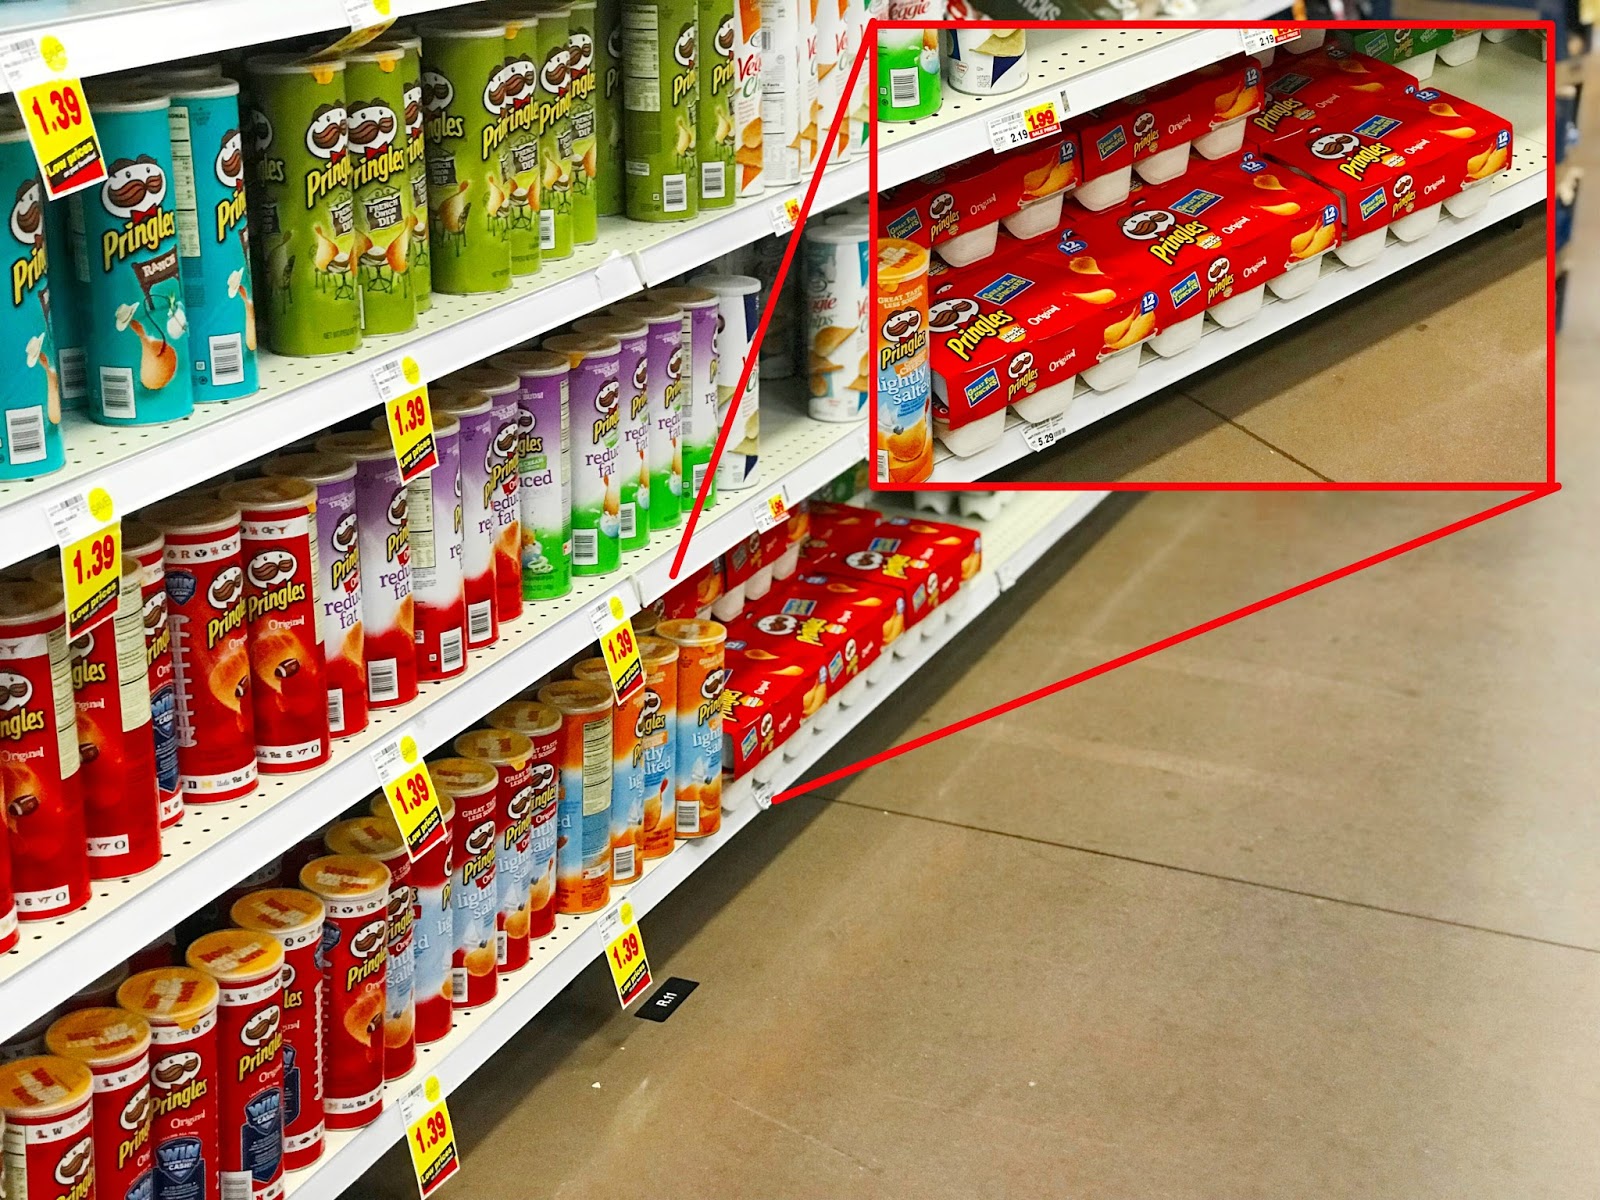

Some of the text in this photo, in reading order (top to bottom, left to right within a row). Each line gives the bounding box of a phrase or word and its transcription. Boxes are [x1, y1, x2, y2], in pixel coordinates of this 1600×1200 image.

[1259, 36, 1274, 46] 2.19
[1246, 68, 1257, 81] 12
[1416, 91, 1433, 100] 12
[32, 86, 82, 135] 1.39
[1028, 109, 1054, 129] 1.99
[1254, 98, 1303, 132] Pringles
[579, 127, 591, 138] DIP
[1032, 124, 1060, 137] SALE PRICE
[1168, 114, 1192, 134] Original
[1011, 129, 1028, 143] 2.19
[1101, 135, 1124, 155] LUNCHES
[1134, 128, 1159, 157] Pringles
[1498, 132, 1508, 143] 12
[1061, 143, 1074, 157] 12
[1404, 138, 1430, 155] Original
[45, 141, 94, 178] Low prices
[522, 160, 535, 171] DIP
[1242, 161, 1260, 171] 12
[1340, 143, 1391, 180] Pringles
[1424, 176, 1446, 195] Original
[369, 198, 398, 213] FRENCH
[373, 207, 396, 219] ONION
[970, 194, 996, 215] Original
[1324, 207, 1336, 219] 12
[1392, 191, 1416, 217] Pringles
[378, 215, 396, 227] DIP
[890, 215, 916, 235] GREAT FOR
[893, 219, 919, 239] LUNCHES
[931, 210, 959, 242] Pringles
[1222, 216, 1250, 234] Original
[103, 208, 175, 272] Pringles
[1060, 241, 1080, 252] 12
[1150, 220, 1208, 265] Pringles
[142, 253, 176, 278] RANCH
[1243, 256, 1267, 278] Original
[981, 277, 1017, 301] GREAT FOR
[992, 278, 1026, 301] LUNCHES
[1208, 273, 1234, 304] Pringles
[878, 294, 904, 304] GREAT
[884, 299, 900, 308] LESS
[1142, 294, 1155, 308] 12
[1028, 305, 1060, 326] Original
[947, 310, 1013, 361] Pringles
[881, 332, 926, 369] Pringles
[1049, 349, 1076, 372] Original
[878, 365, 927, 395] lightly
[967, 375, 995, 397] GREAT FOR
[1008, 368, 1038, 401] Pringles
[970, 379, 998, 402] LUNCHES
[395, 396, 425, 435] 1.39
[669, 426, 681, 441] fat
[1038, 433, 1054, 446] 5.29
[400, 438, 431, 468] Low prices
[636, 437, 648, 452] fat
[599, 462, 615, 478] fat
[498, 509, 516, 526] fat
[73, 534, 115, 585] 1.39
[394, 581, 410, 600] fat
[70, 583, 117, 623] Low prices
[249, 582, 305, 622] Pringles
[268, 616, 304, 631] Original
[339, 609, 358, 629] fat
[608, 629, 632, 663] 1.39
[616, 662, 639, 690] Low prices
[504, 774, 524, 784] GREAT
[510, 778, 522, 787] LESS
[396, 773, 429, 815] 1.39
[462, 807, 485, 818] GREAT
[468, 814, 482, 822] LESS
[407, 811, 438, 846] Low prices
[613, 933, 639, 969] 1.39
[620, 963, 645, 995] Low prices
[118, 1074, 127, 1083] W
[150, 1078, 207, 1121] Pringles
[247, 1094, 280, 1116] WIN
[170, 1109, 205, 1129] Original
[52, 1127, 62, 1136] W
[415, 1111, 446, 1154] 1.39
[159, 1144, 200, 1161] WIN
[168, 1163, 192, 1171] CASH!
[421, 1147, 452, 1184] Low prices
